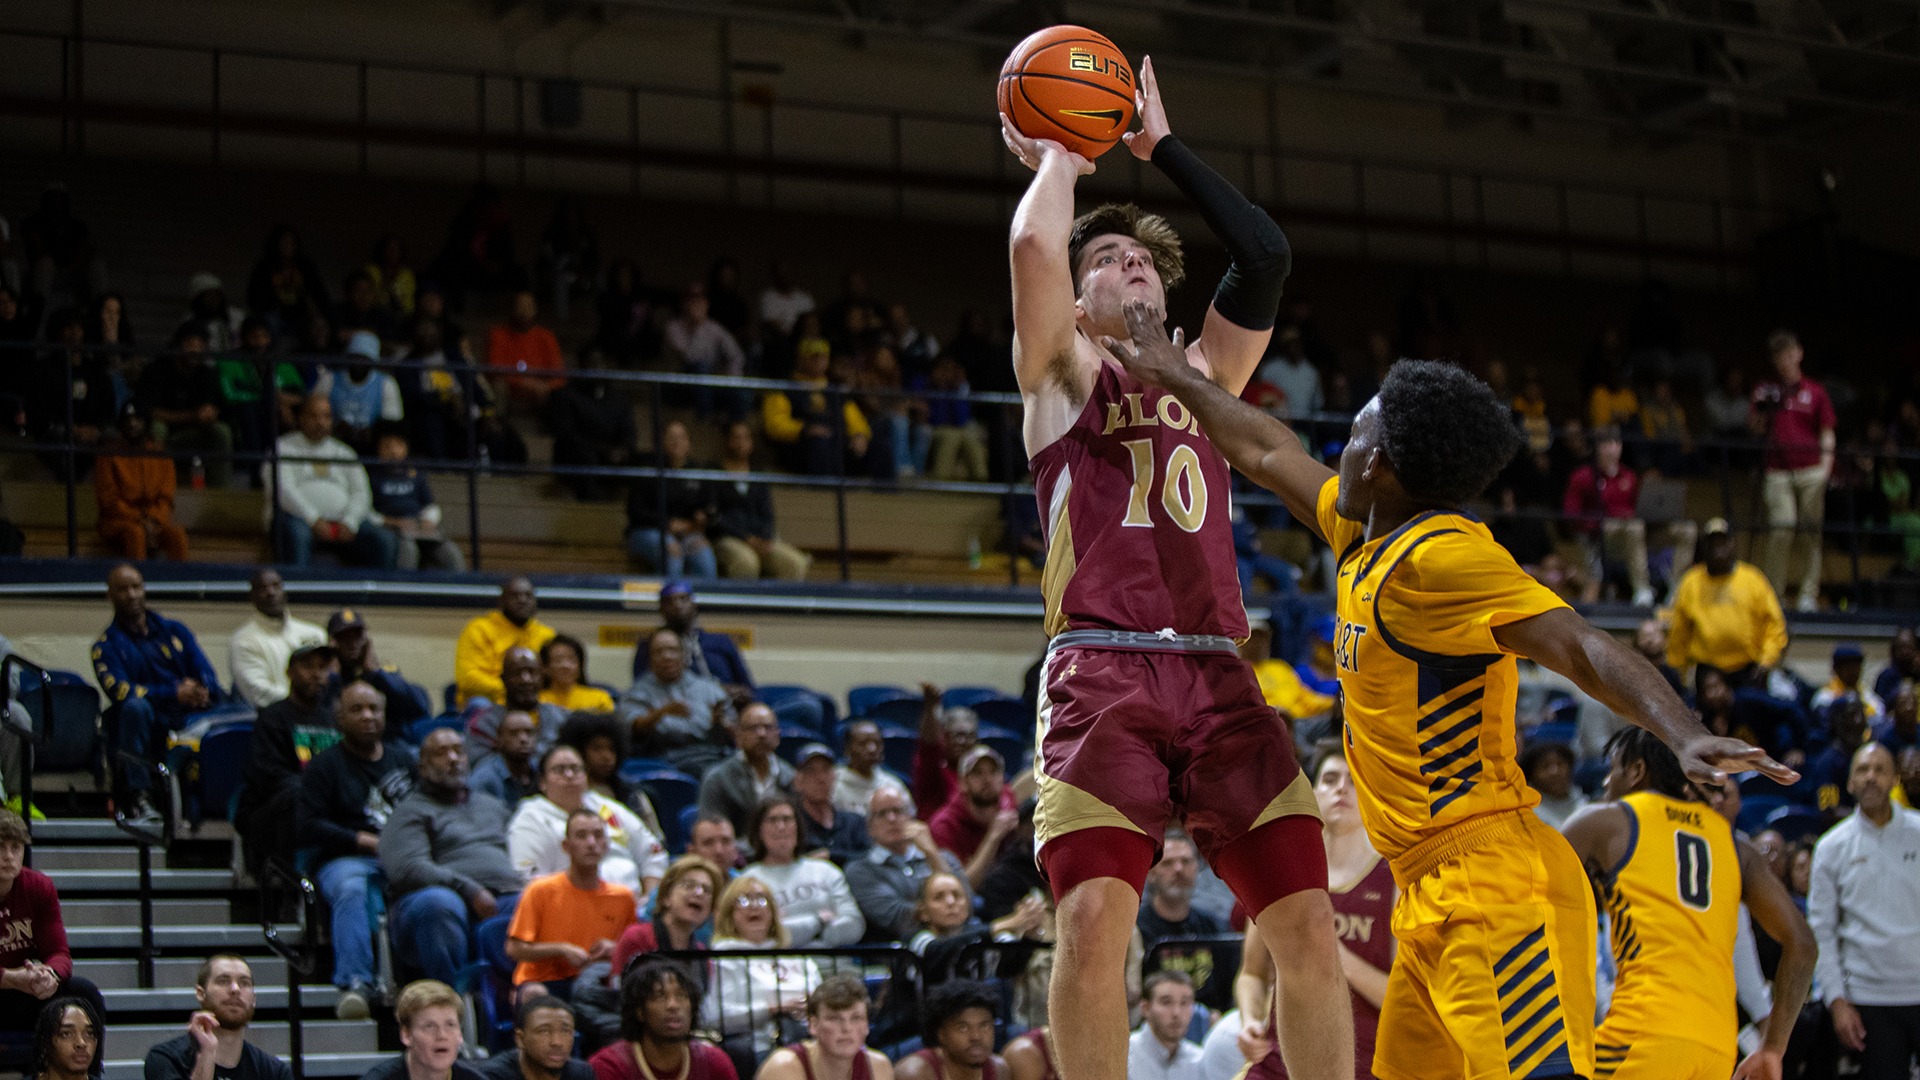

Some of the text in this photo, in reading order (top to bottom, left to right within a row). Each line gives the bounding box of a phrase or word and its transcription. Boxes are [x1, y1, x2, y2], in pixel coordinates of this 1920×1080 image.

[1070, 52, 1131, 88] ELITE
[1120, 438, 1208, 533] 10
[1674, 828, 1712, 913] 0
